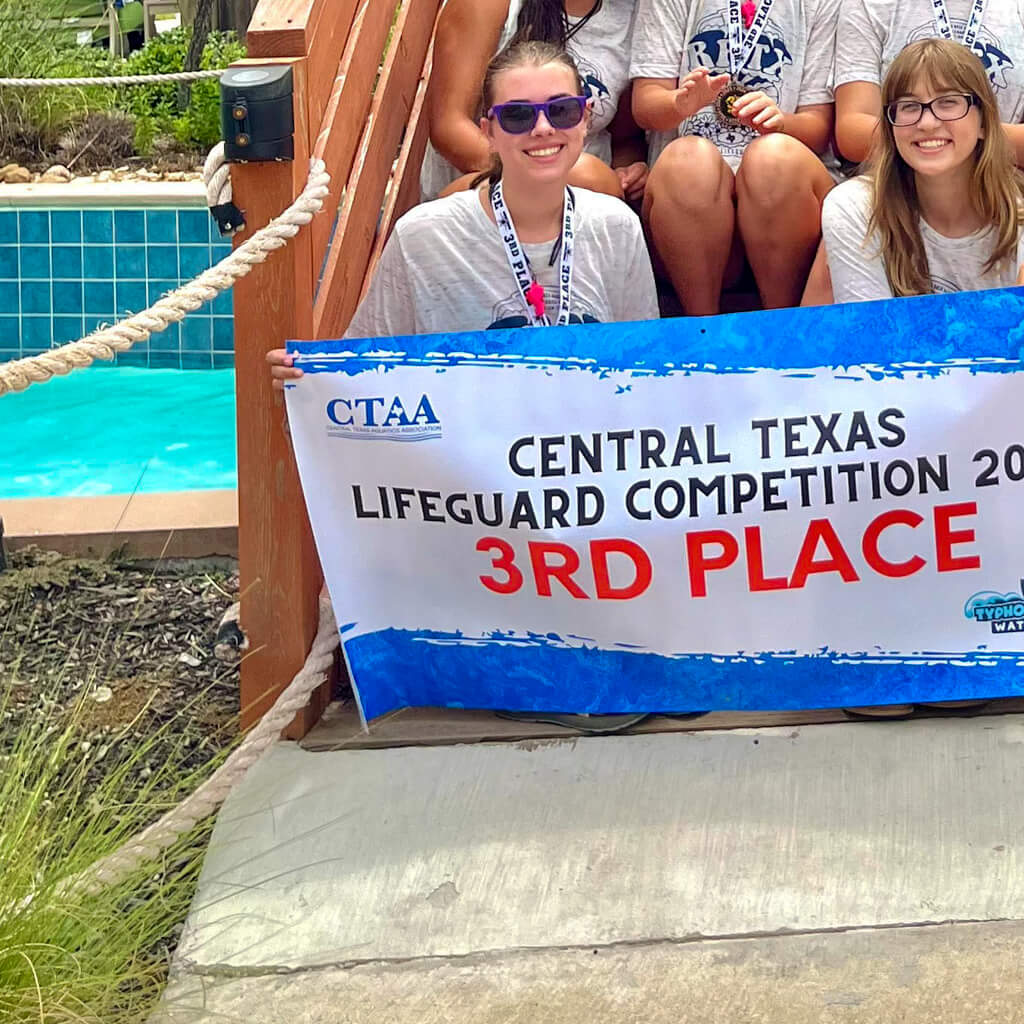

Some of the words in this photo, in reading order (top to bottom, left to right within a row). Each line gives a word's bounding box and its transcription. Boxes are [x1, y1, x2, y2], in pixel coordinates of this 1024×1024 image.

[744, 29, 758, 49] 3RD
[504, 234, 520, 257] 3RD
[565, 216, 574, 239] 3RD
[562, 265, 571, 312] PLACE
[326, 394, 441, 426] CTAA
[508, 424, 731, 477] CENTRAL
[751, 407, 906, 460] TEXAS
[351, 485, 605, 530] LIFEGUARD
[625, 454, 950, 521] COMPETITION
[475, 536, 653, 601] 3RD
[685, 501, 981, 598] PLACE
